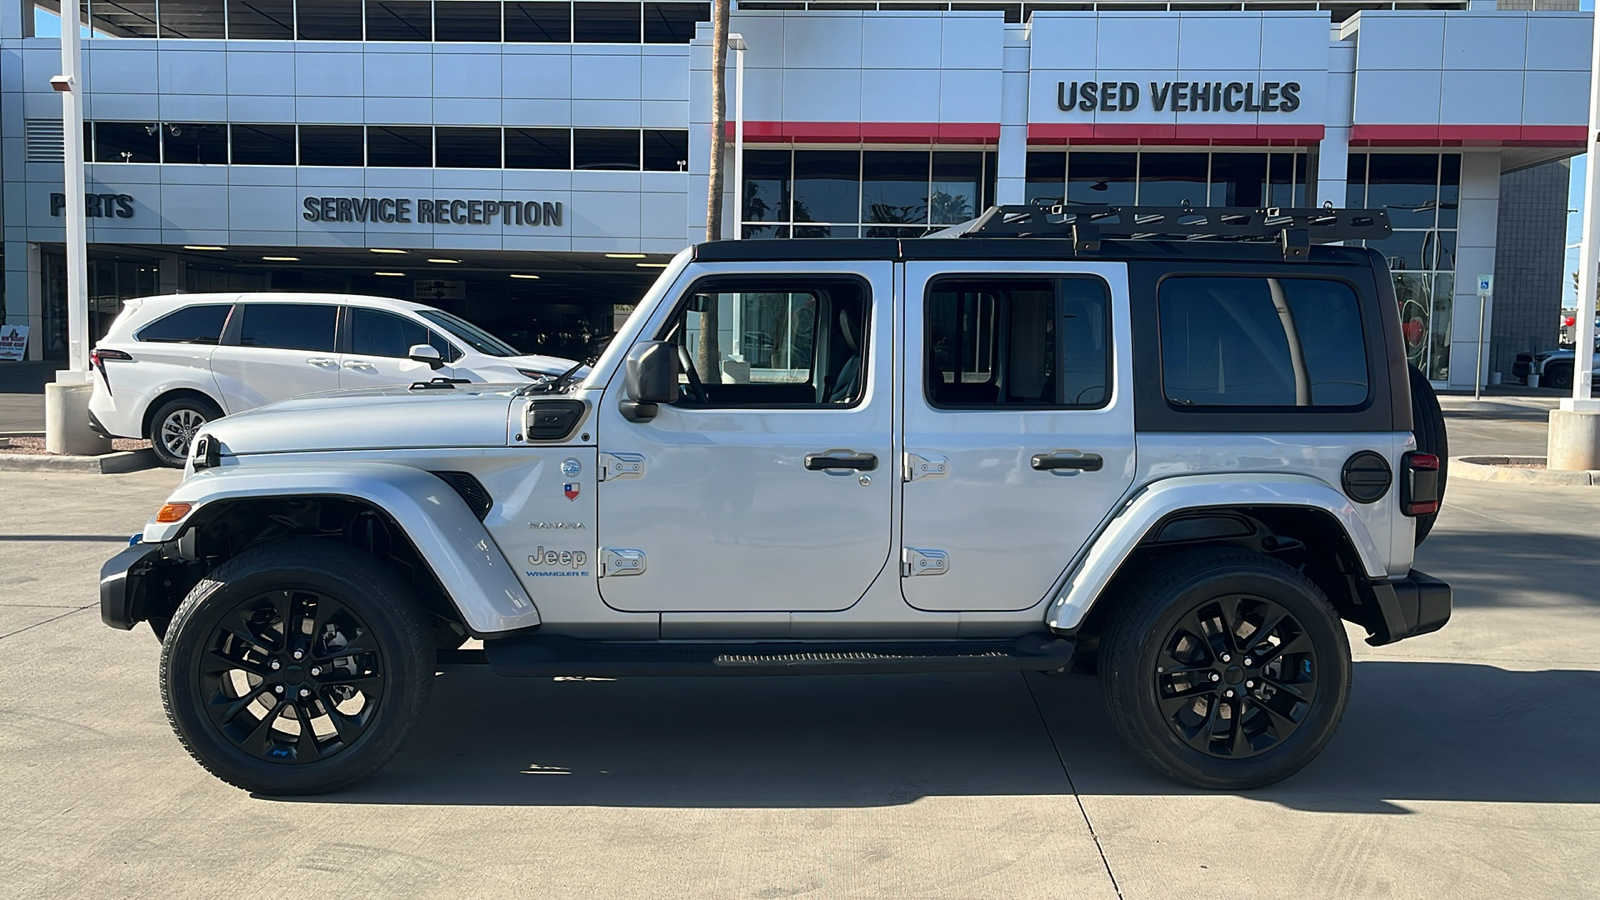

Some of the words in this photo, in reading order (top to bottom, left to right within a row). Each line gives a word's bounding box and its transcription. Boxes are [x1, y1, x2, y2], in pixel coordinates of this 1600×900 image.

[1057, 81, 1140, 112] USED
[1150, 81, 1301, 112] VEHICLES
[50, 192, 134, 219] PRTS
[303, 197, 411, 223] SERVICE
[417, 199, 563, 226] RECEPTION
[528, 546, 587, 569] Jeep
